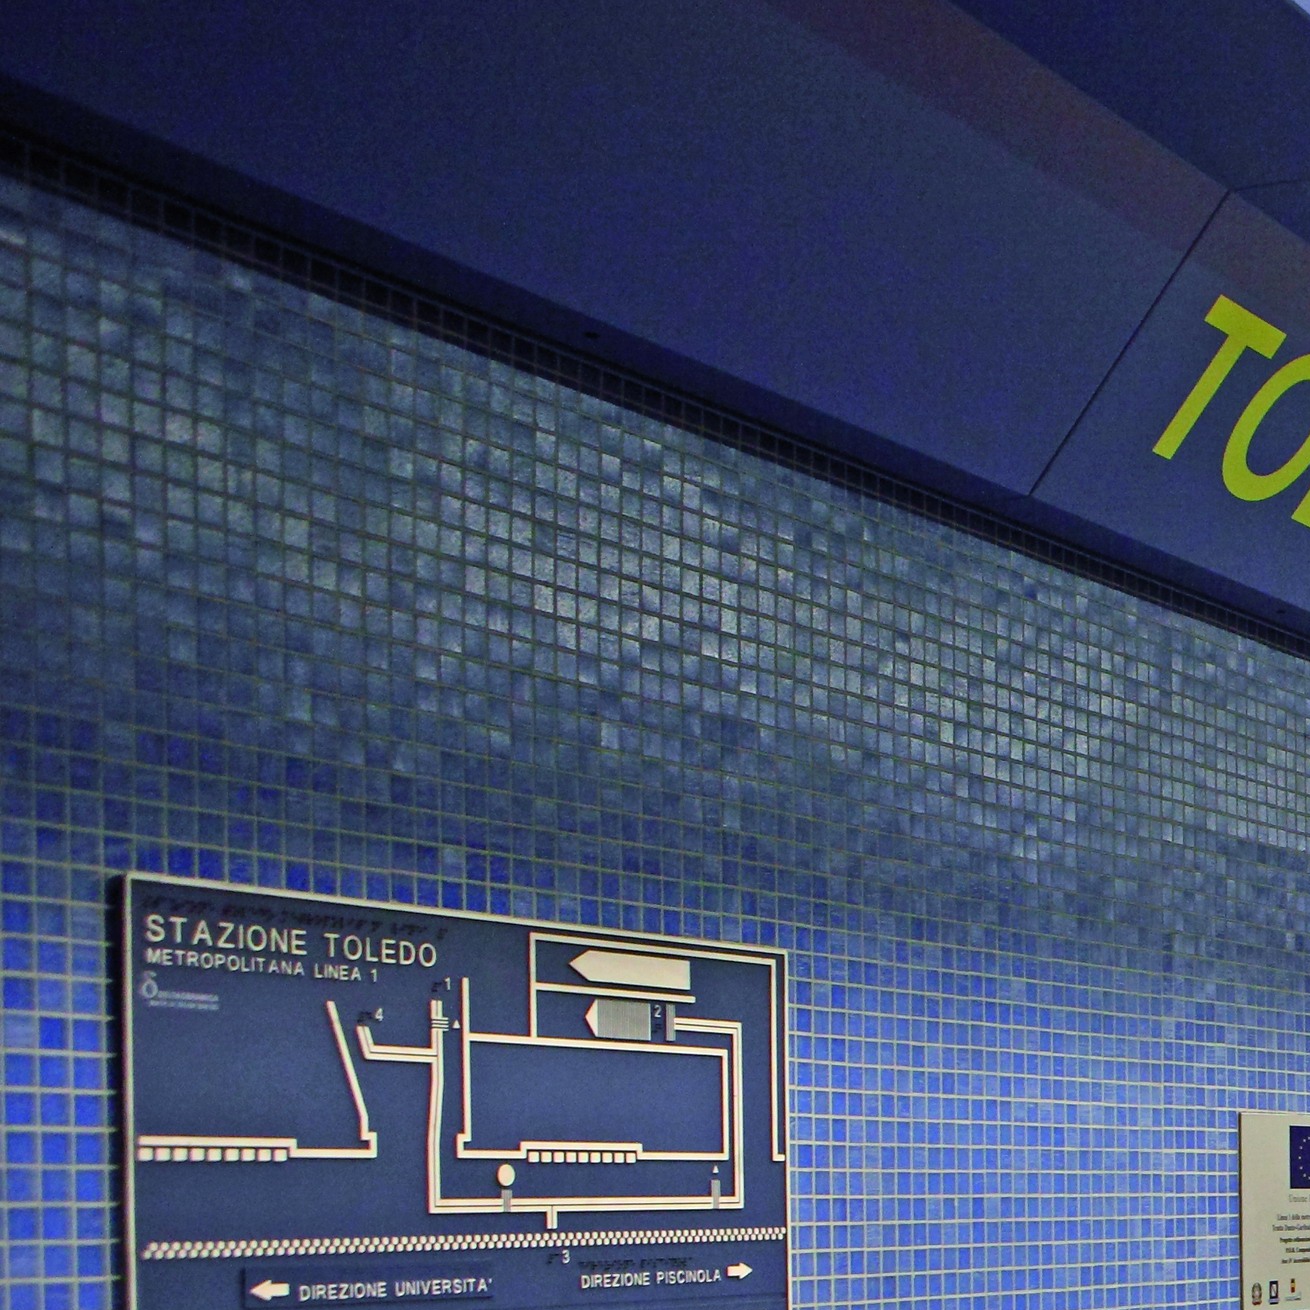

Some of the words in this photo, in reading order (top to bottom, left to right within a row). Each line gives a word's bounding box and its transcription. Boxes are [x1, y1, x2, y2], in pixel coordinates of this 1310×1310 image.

[145, 914, 307, 956] STAZIONE
[324, 931, 438, 968] TOLEDO
[146, 948, 305, 977] METROPOLITANA
[314, 963, 361, 982] LINEA
[370, 968, 378, 983] 1
[444, 978, 452, 990] 1
[374, 1008, 384, 1021] 4
[654, 1004, 662, 1017] 2
[562, 1250, 571, 1264] 3
[581, 1271, 650, 1289] DIREZIONE
[656, 1269, 721, 1285] PISCINOLA
[299, 1282, 387, 1301] DIREZIONE
[395, 1278, 492, 1297] UNIVERSITA'
